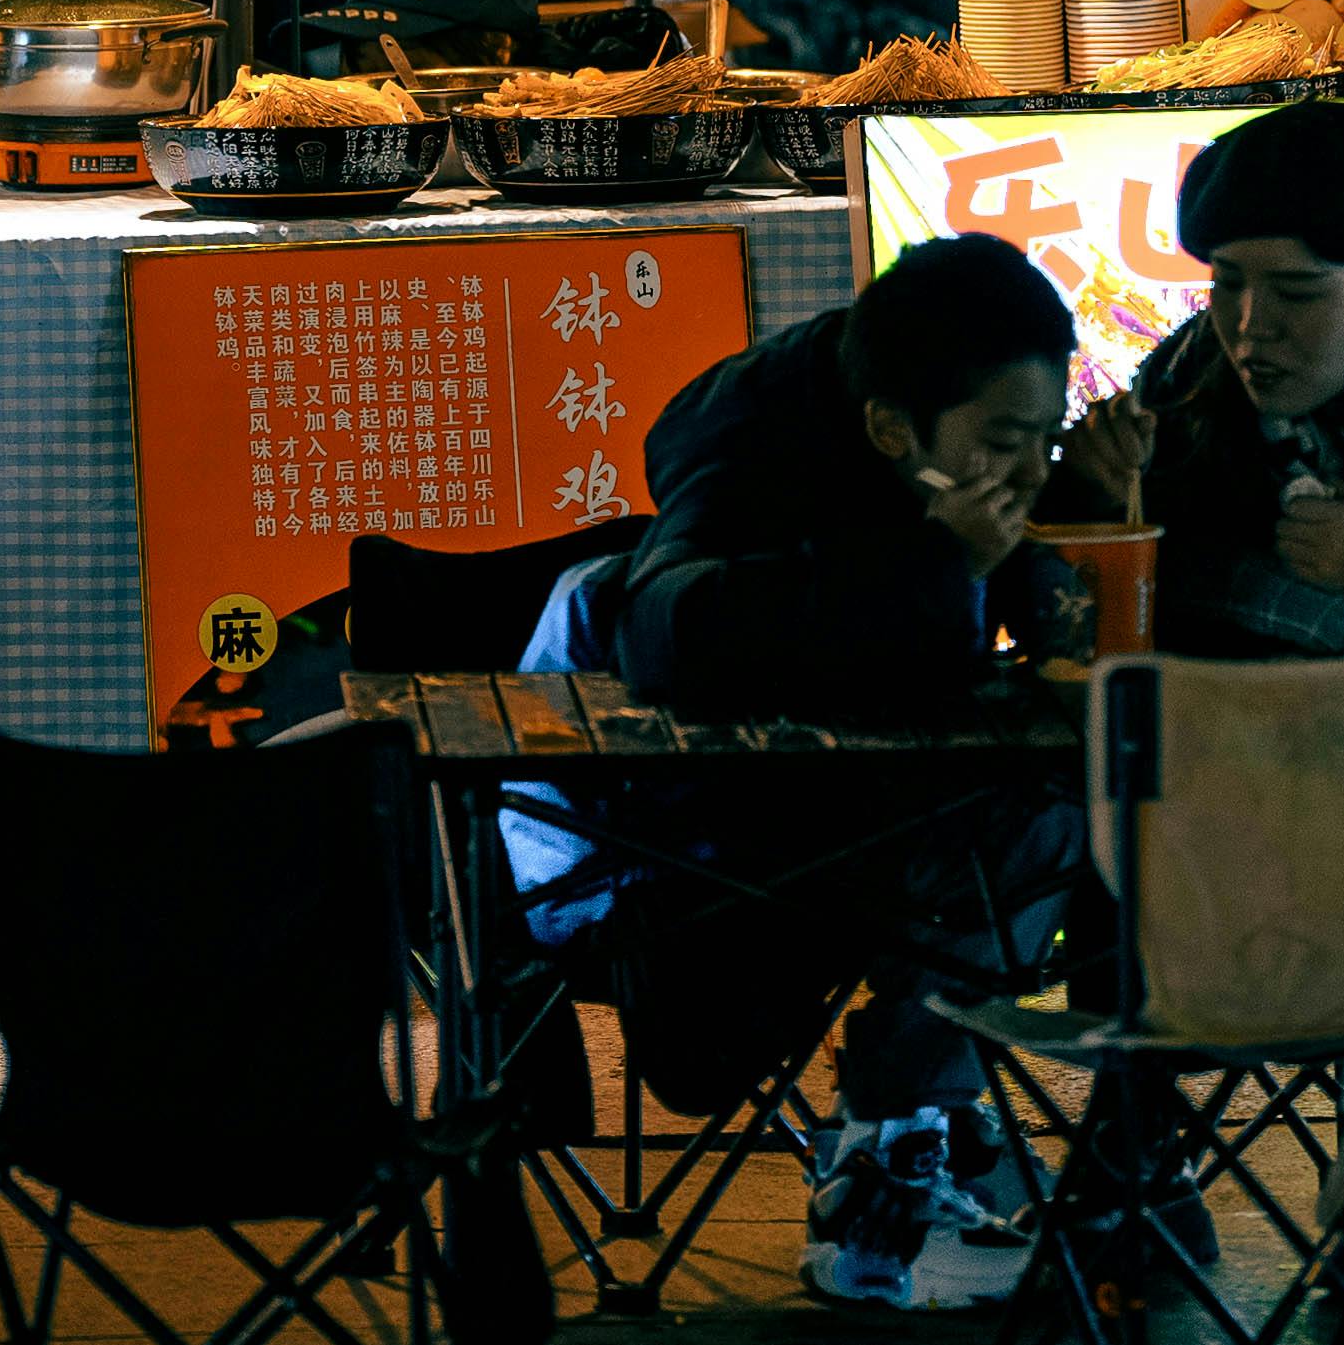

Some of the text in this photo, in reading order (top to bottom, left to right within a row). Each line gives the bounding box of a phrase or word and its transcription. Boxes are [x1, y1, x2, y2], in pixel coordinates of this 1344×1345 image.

[352, 279, 387, 532] 上用竹签串起来的土鸡
[461, 274, 496, 528] 钵钵鸡起源于四川乐山
[540, 272, 631, 526] 钵钵鸡
[636, 260, 654, 299] 乐山
[242, 285, 277, 538] 天菜品丰富风味独特的
[210, 607, 266, 665] 麻
